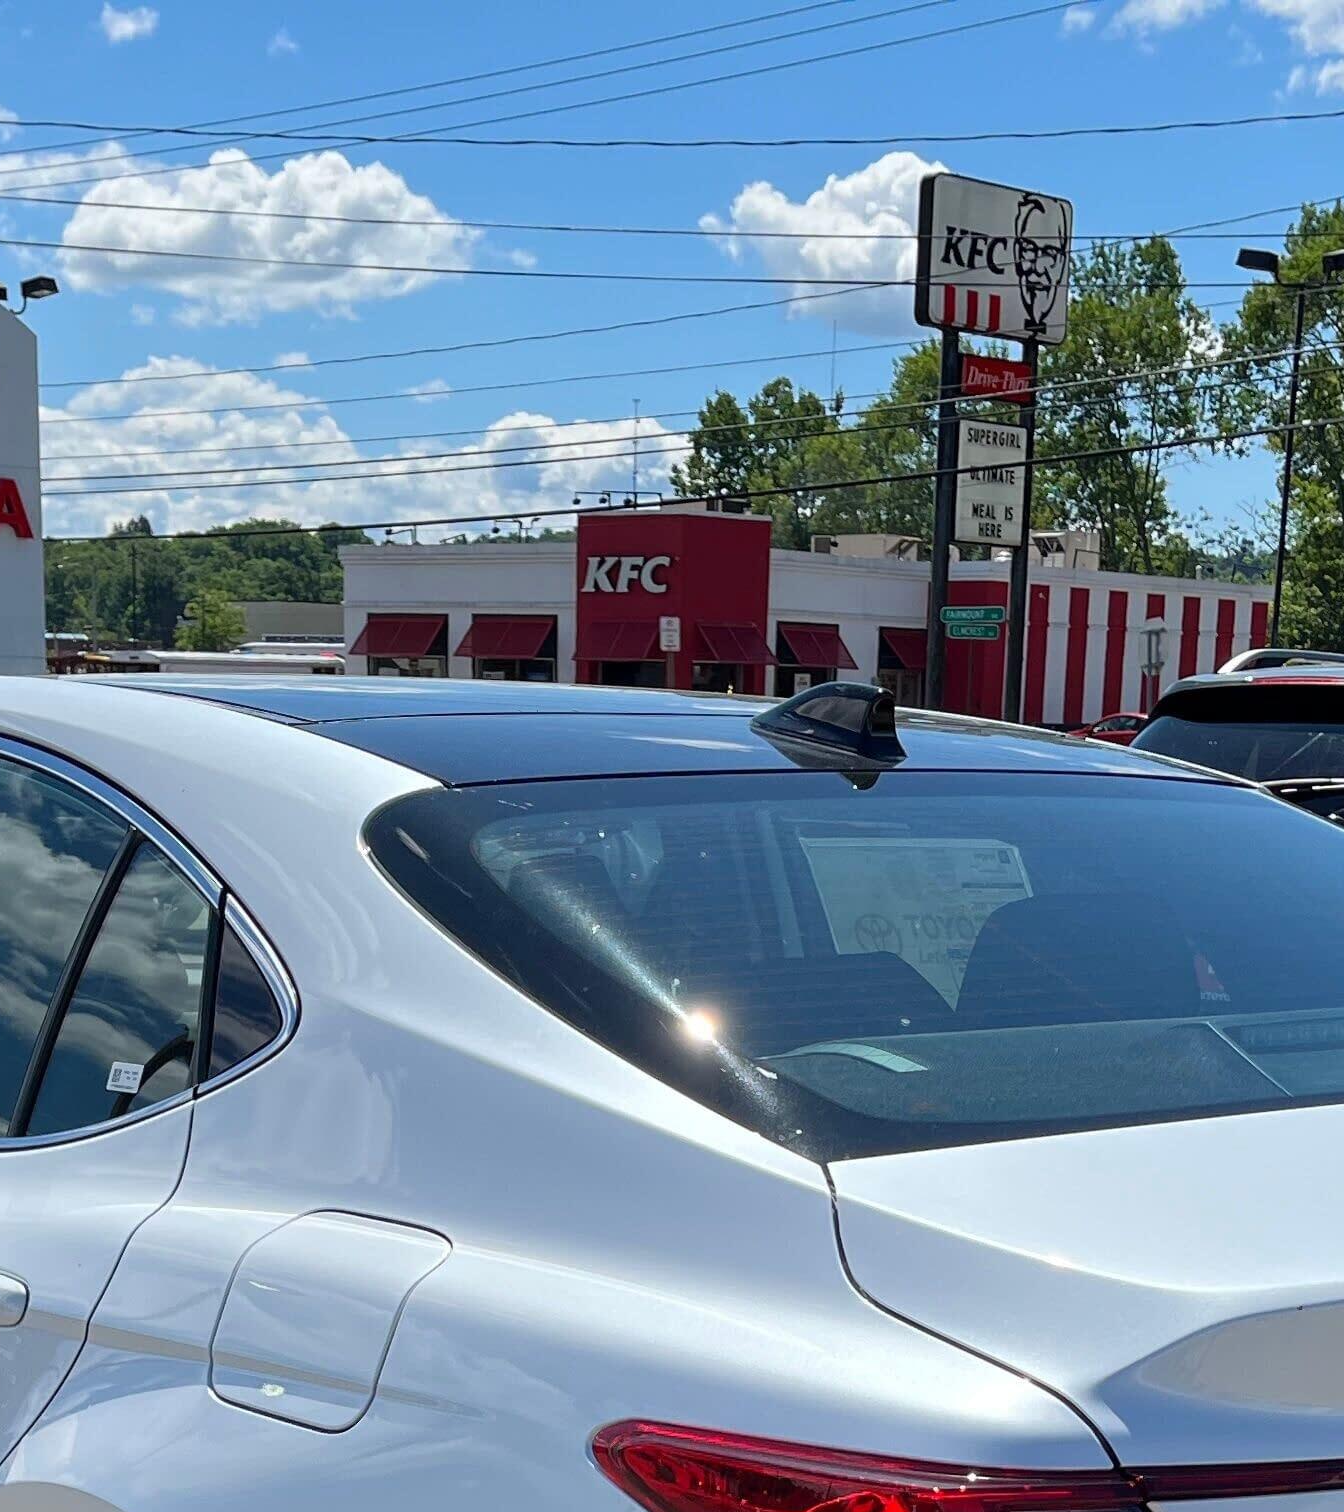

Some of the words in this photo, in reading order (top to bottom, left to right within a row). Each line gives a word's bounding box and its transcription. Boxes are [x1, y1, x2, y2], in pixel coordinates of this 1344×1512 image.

[941, 225, 1008, 275] KFC
[968, 427, 1021, 449] SUPERGIRL
[970, 466, 1015, 485] ULTIMATE
[972, 502, 996, 519] MEAL
[1004, 505, 1014, 520] IS
[978, 522, 1002, 538] HERE
[581, 556, 671, 593] KFC
